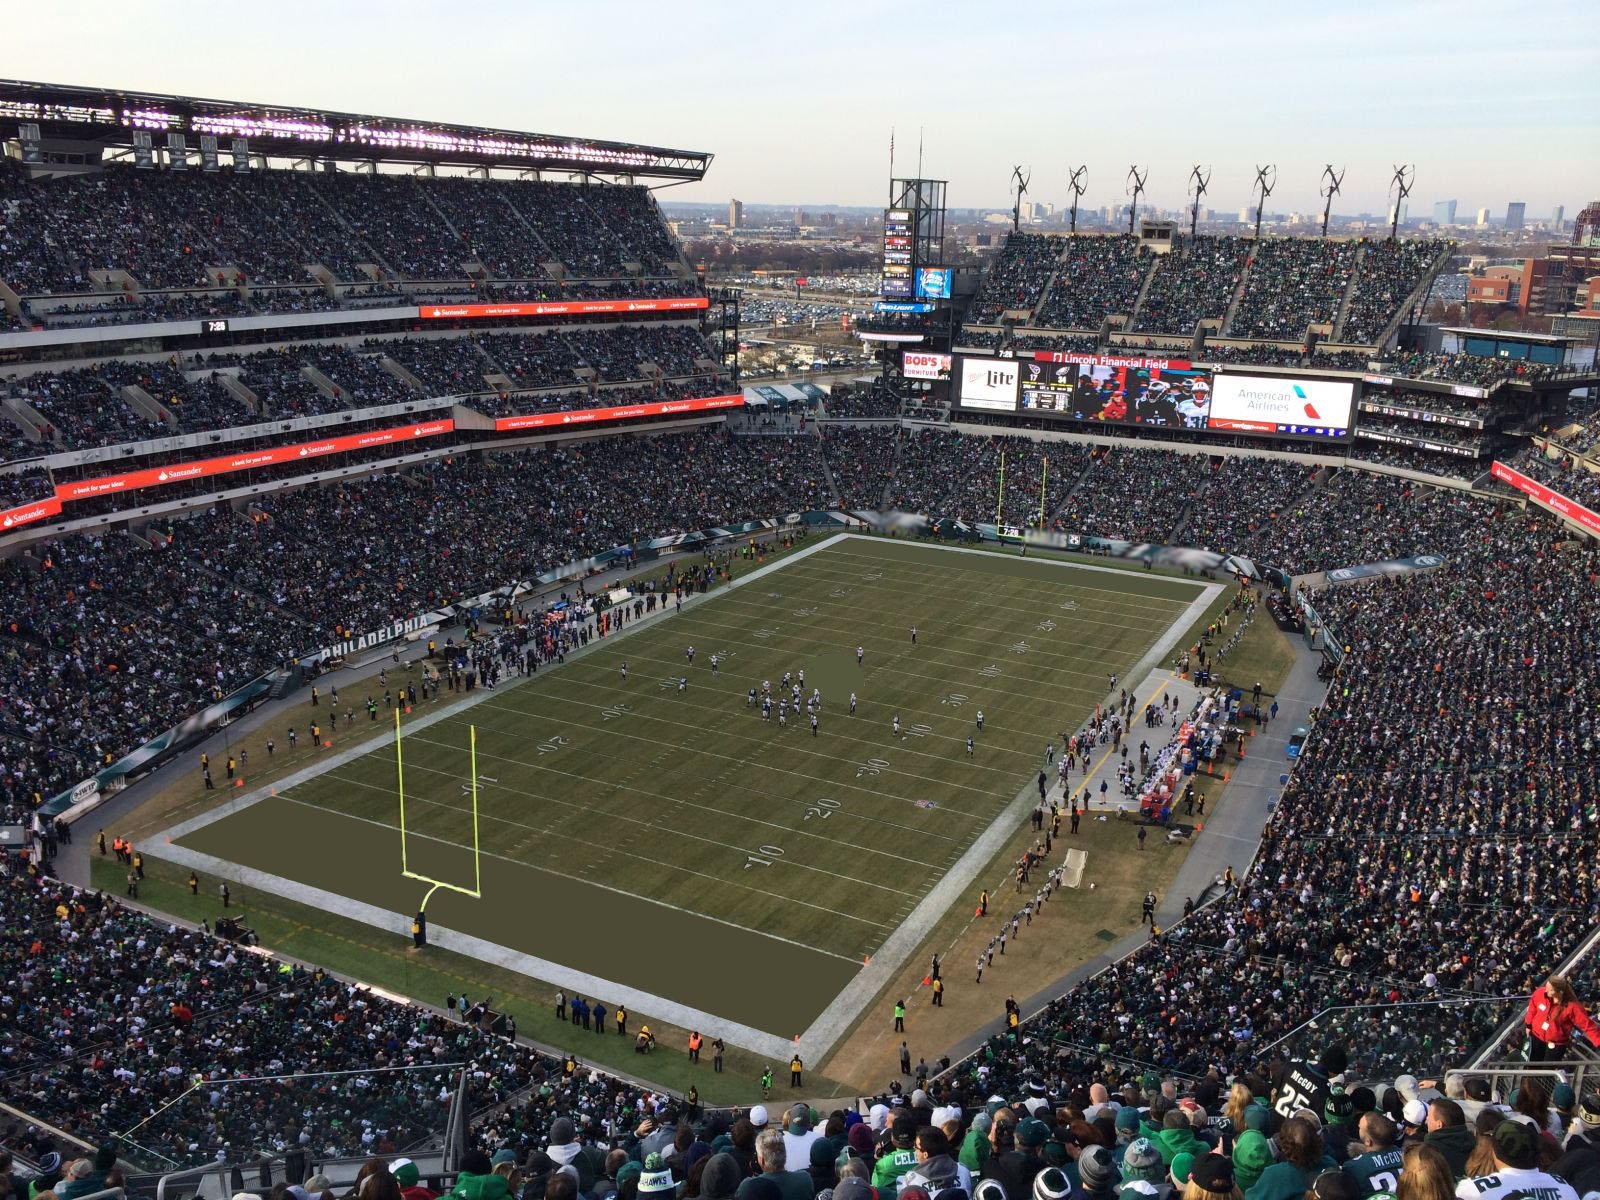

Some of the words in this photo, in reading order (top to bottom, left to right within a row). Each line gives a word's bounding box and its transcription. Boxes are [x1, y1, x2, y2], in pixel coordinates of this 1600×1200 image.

[441, 308, 469, 316] Santander
[905, 355, 937, 367] BOB'S
[1065, 354, 1098, 365] Lincoln
[1100, 357, 1142, 368] Financial
[1144, 360, 1168, 370] Field
[904, 368, 937, 377] FURNITURE
[986, 370, 1014, 388] Lite
[1238, 388, 1291, 401] American
[1247, 400, 1289, 412] Airlines
[307, 443, 336, 453] Santander
[168, 466, 202, 480] Santander
[98, 483, 111, 491] your
[13, 507, 47, 524] Santander
[321, 615, 429, 661] PHILADELPHIA
[536, 735, 570, 752] 20
[857, 758, 890, 776] 30
[805, 798, 842, 819] 20
[748, 845, 785, 867] 10
[1290, 1070, 1318, 1094] McCOY
[1275, 1083, 1310, 1119] 25
